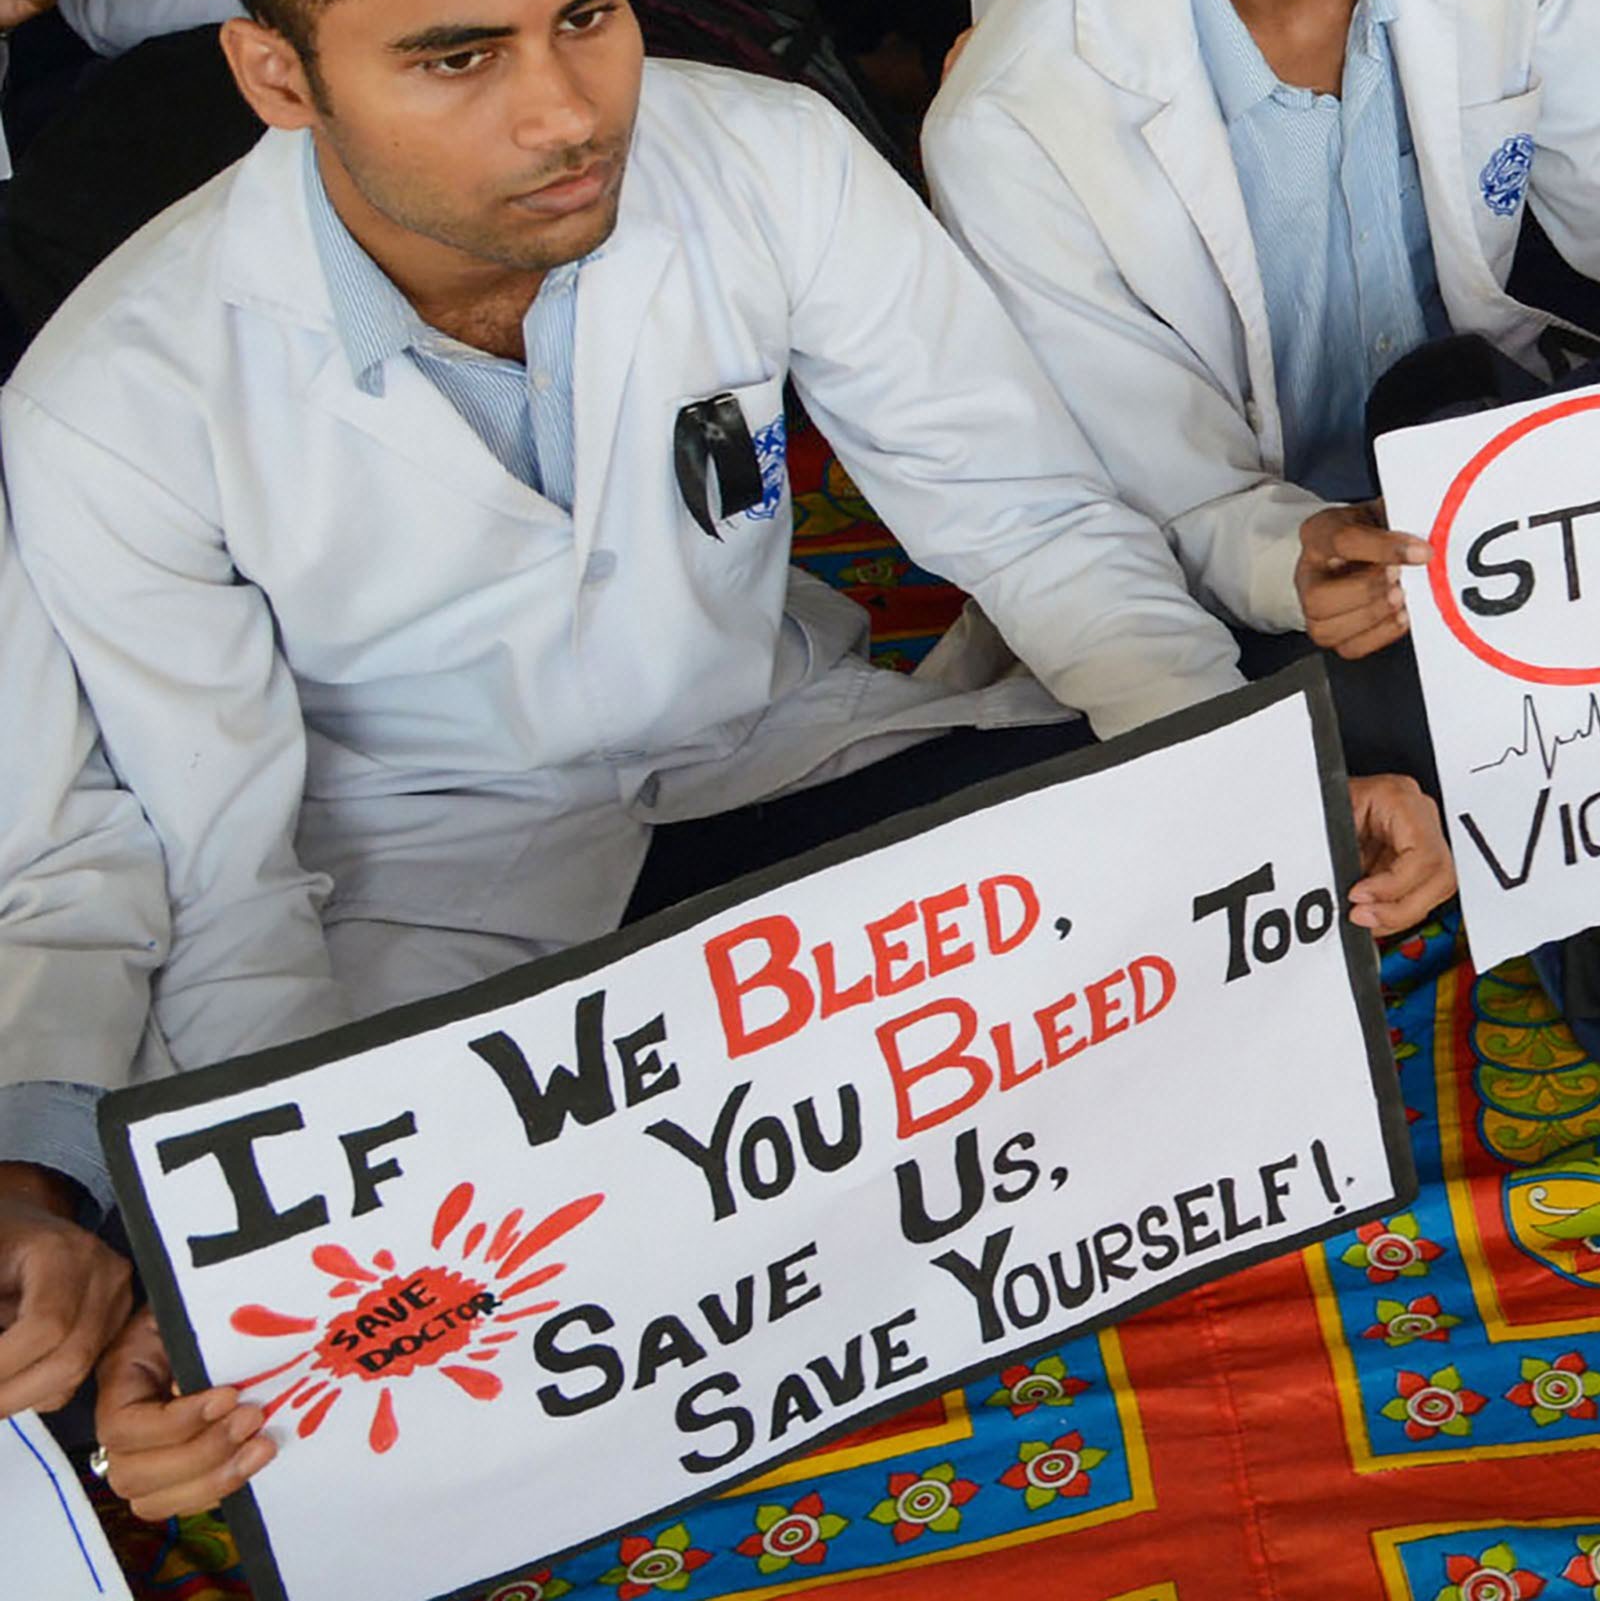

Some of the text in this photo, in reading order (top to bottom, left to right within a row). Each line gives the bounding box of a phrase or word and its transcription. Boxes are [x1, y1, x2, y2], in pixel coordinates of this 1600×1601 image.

[874, 955, 1178, 1141] BLEED
[157, 1100, 417, 1267] IF
[330, 1277, 437, 1351] SAVE
[356, 1292, 504, 1373] DOCTOR
